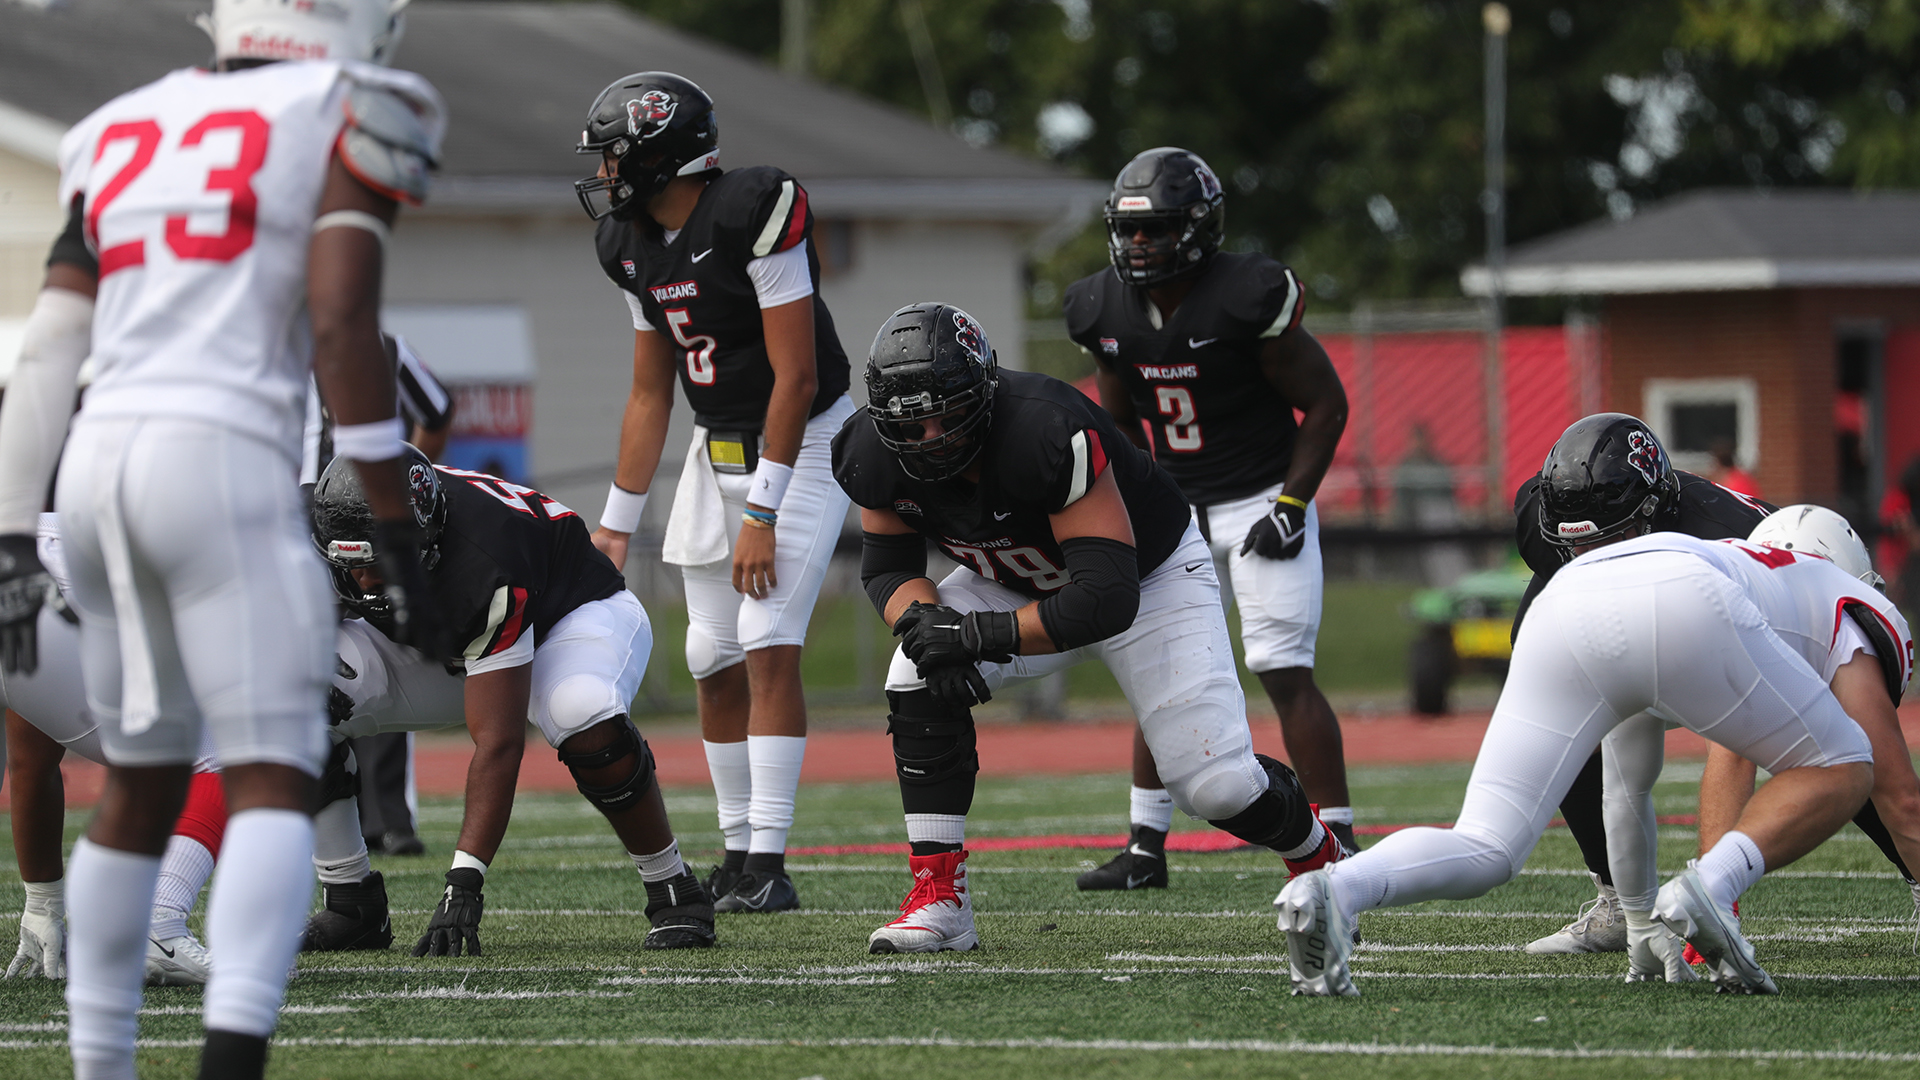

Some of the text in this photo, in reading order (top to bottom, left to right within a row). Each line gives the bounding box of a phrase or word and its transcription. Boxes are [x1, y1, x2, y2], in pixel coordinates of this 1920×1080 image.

[85, 109, 270, 281] 23
[650, 281, 698, 303] VULCANS
[665, 307, 717, 386] 5
[1138, 364, 1198, 380] VULCANS
[1155, 385, 1204, 453] 2
[1560, 524, 1591, 534] Riddell
[941, 541, 1073, 592] 78
